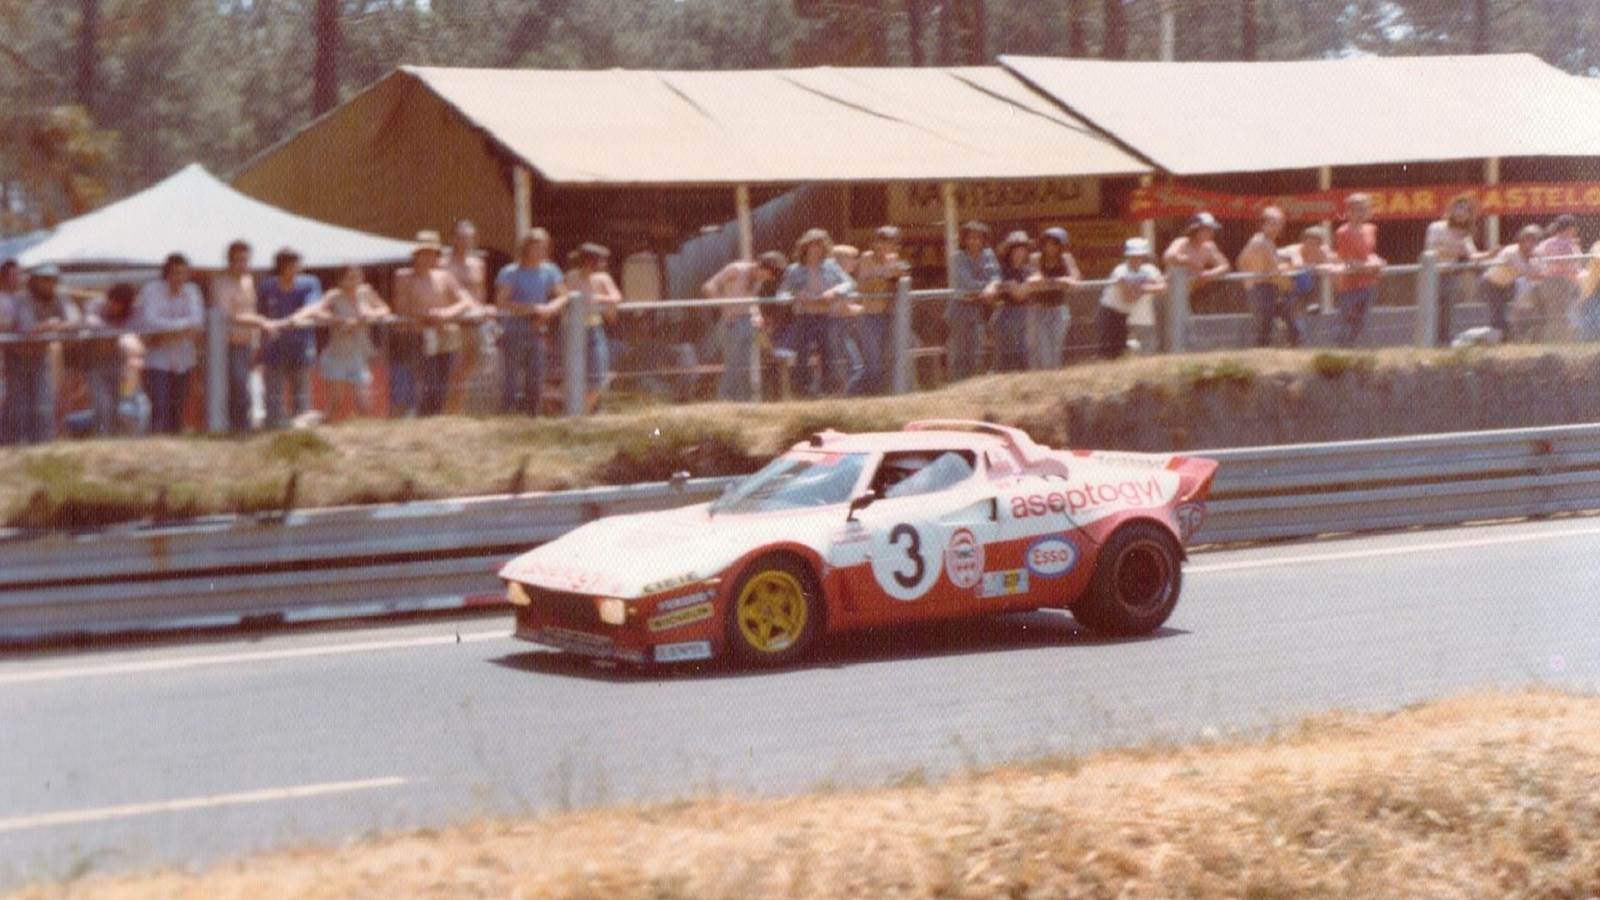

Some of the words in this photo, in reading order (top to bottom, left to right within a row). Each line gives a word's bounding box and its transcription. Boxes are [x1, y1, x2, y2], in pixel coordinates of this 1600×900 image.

[1370, 190, 1434, 214] BAR
[1011, 476, 1163, 518] aseptogyl
[889, 523, 925, 588] 3
